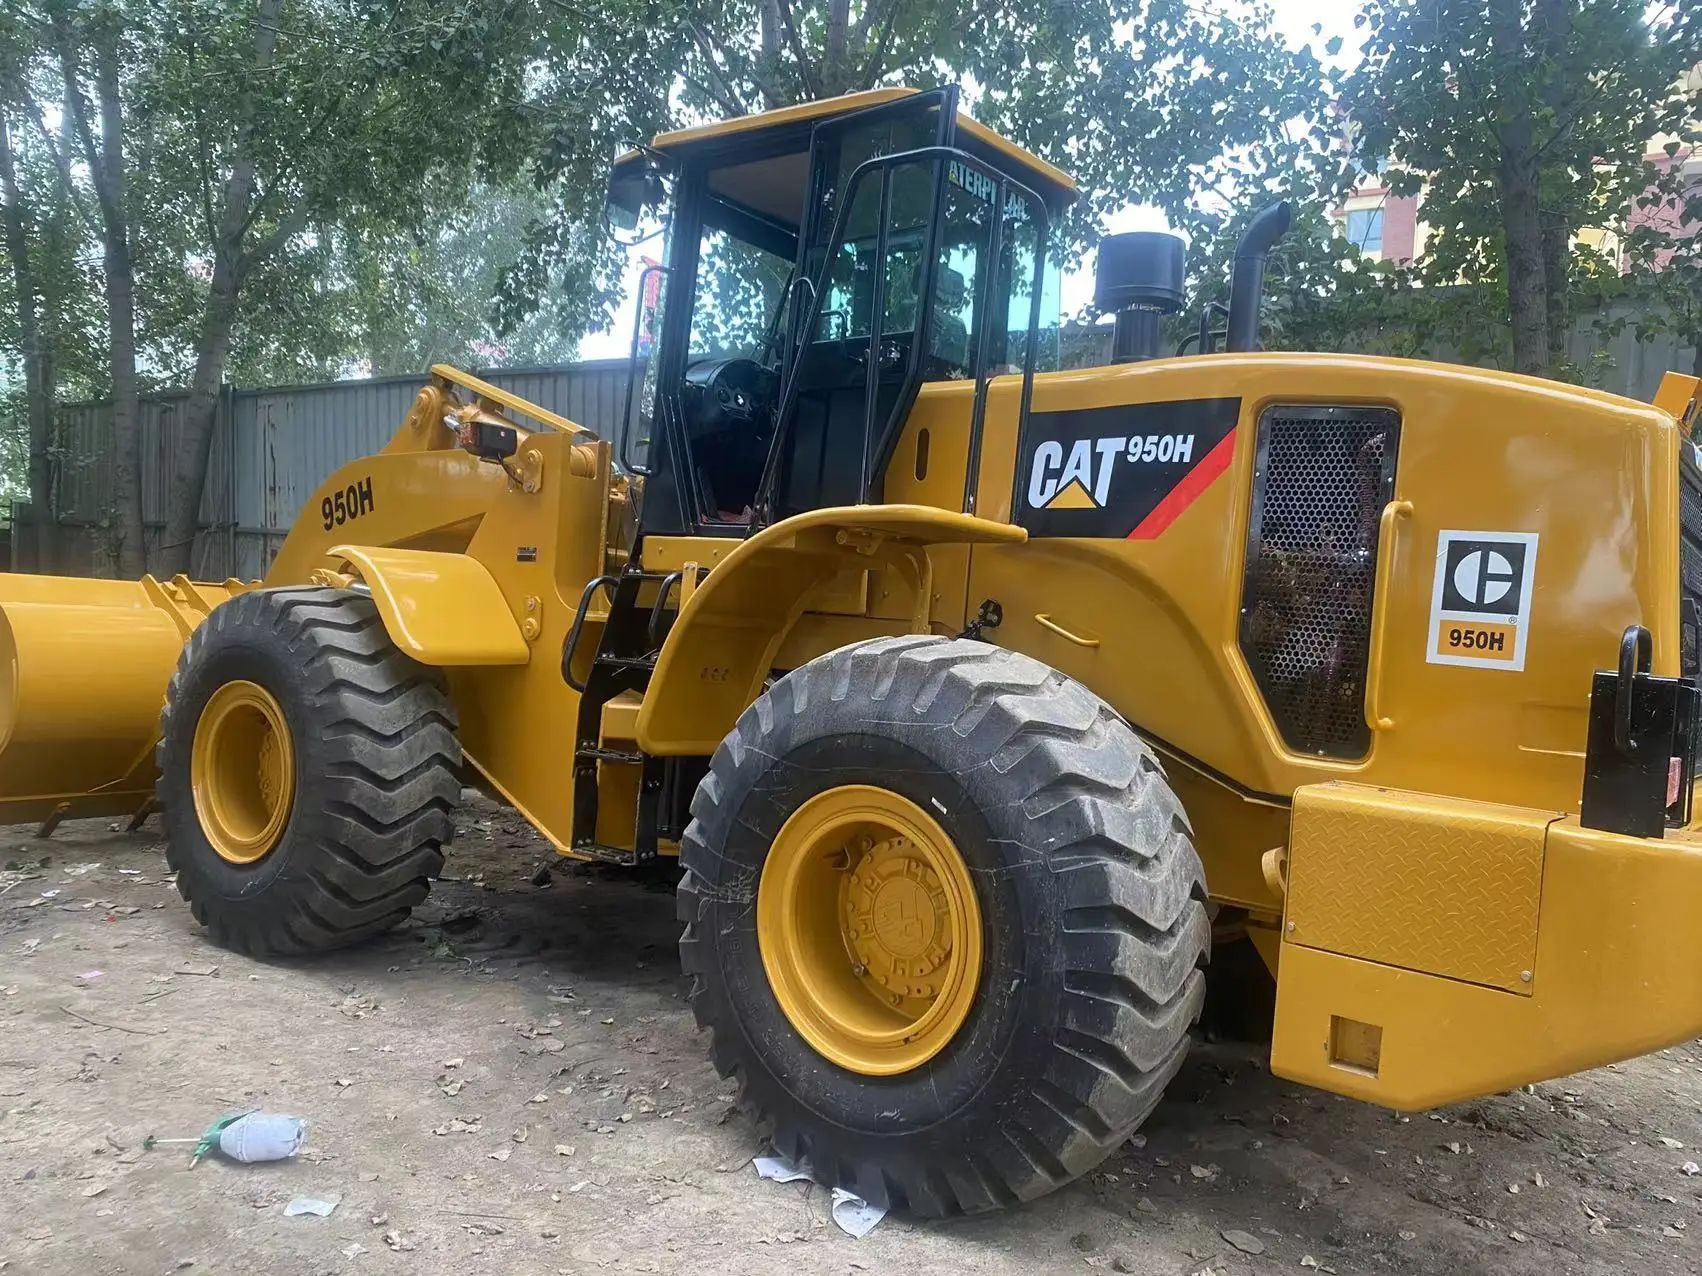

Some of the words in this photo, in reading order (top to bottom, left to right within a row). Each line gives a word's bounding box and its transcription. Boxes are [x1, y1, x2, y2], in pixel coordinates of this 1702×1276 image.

[1028, 437, 1127, 508] CAT
[1126, 434, 1195, 463] 950H
[321, 476, 375, 532] 950H
[1449, 628, 1505, 651] 950H
